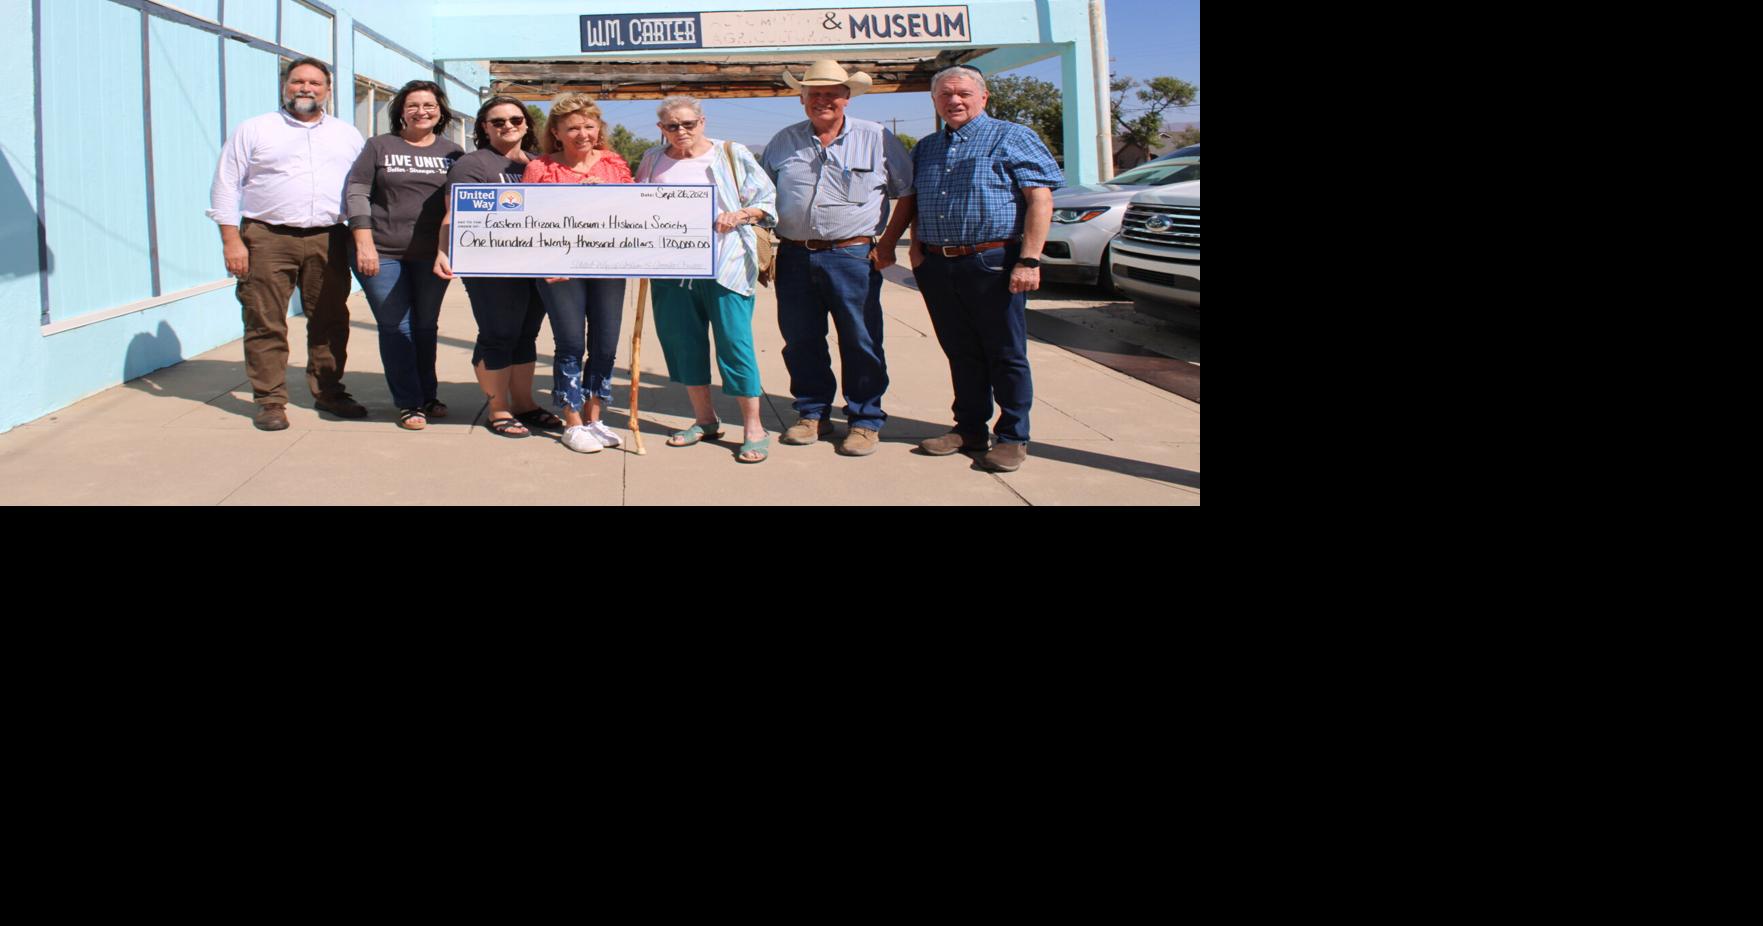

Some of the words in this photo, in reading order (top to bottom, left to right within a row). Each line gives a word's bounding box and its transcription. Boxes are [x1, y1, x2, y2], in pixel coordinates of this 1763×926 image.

[628, 17, 697, 45] CARTER
[822, 11, 842, 30] &
[848, 12, 966, 39] MUSEUM
[384, 154, 412, 167] LIVE
[414, 155, 453, 169] UNITE
[459, 190, 496, 200] United
[472, 200, 496, 211] Way
[485, 213, 522, 229] Eastern
[524, 215, 561, 229] Arizona
[563, 215, 600, 229] Museum
[608, 214, 648, 230] Historical
[650, 214, 688, 234] Society
[460, 230, 487, 248] One
[489, 230, 534, 248] hundred
[539, 232, 571, 255] twenty
[574, 233, 616, 249] thousand
[619, 236, 655, 249] dollars
